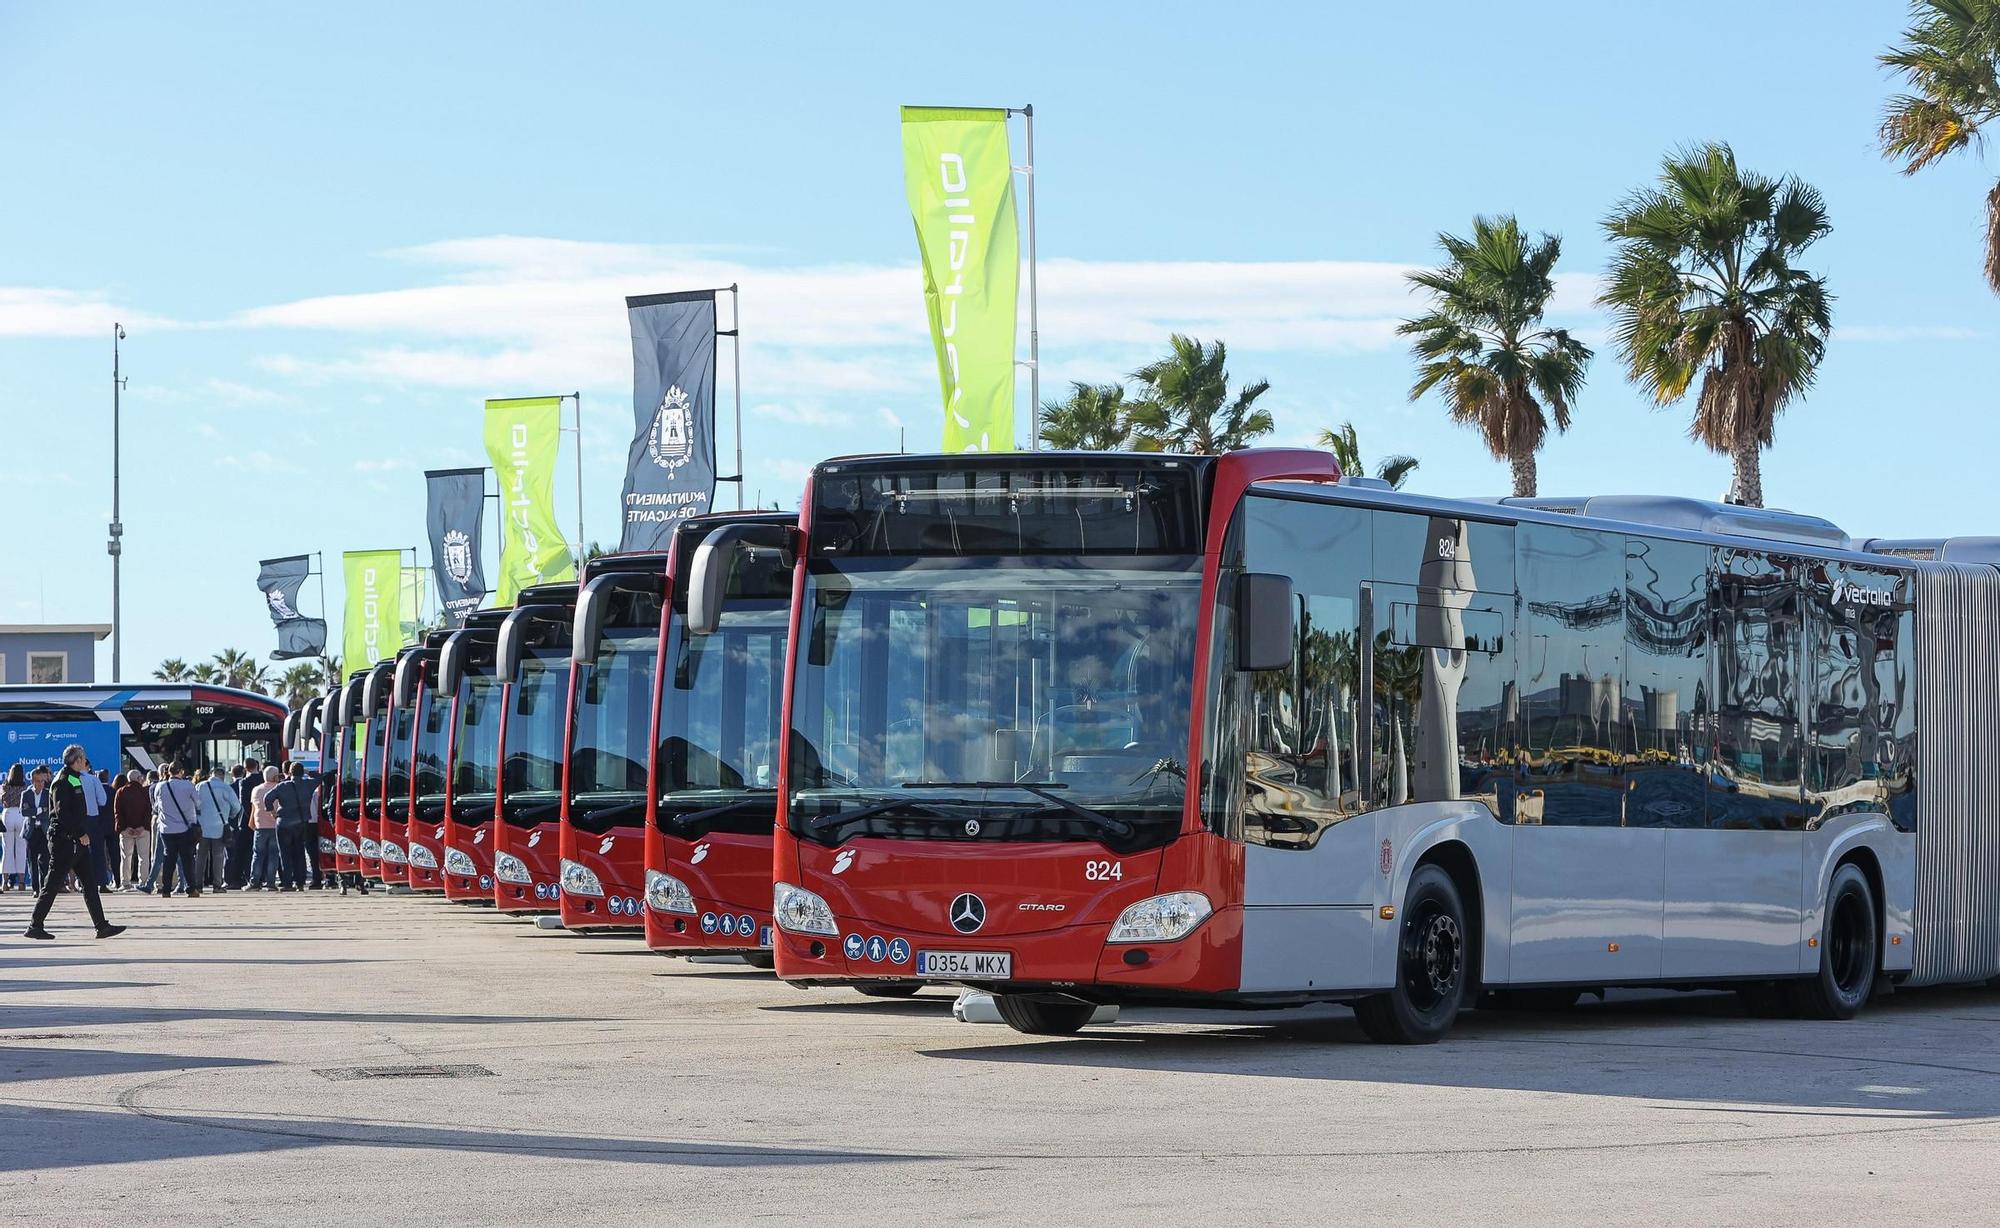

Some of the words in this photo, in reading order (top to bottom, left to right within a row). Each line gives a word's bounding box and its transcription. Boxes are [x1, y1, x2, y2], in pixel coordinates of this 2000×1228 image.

[1439, 538, 1455, 558] 824
[1844, 585, 1891, 607] vectalia
[196, 706, 214, 715] 1050
[236, 722, 270, 731] ENTRADA
[19, 757, 46, 765] Nueva
[47, 757, 64, 765] flot
[1085, 861, 1122, 881] 824
[1018, 903, 1066, 911] CITARO
[928, 955, 969, 973] 0354
[975, 956, 1006, 974] MKX
